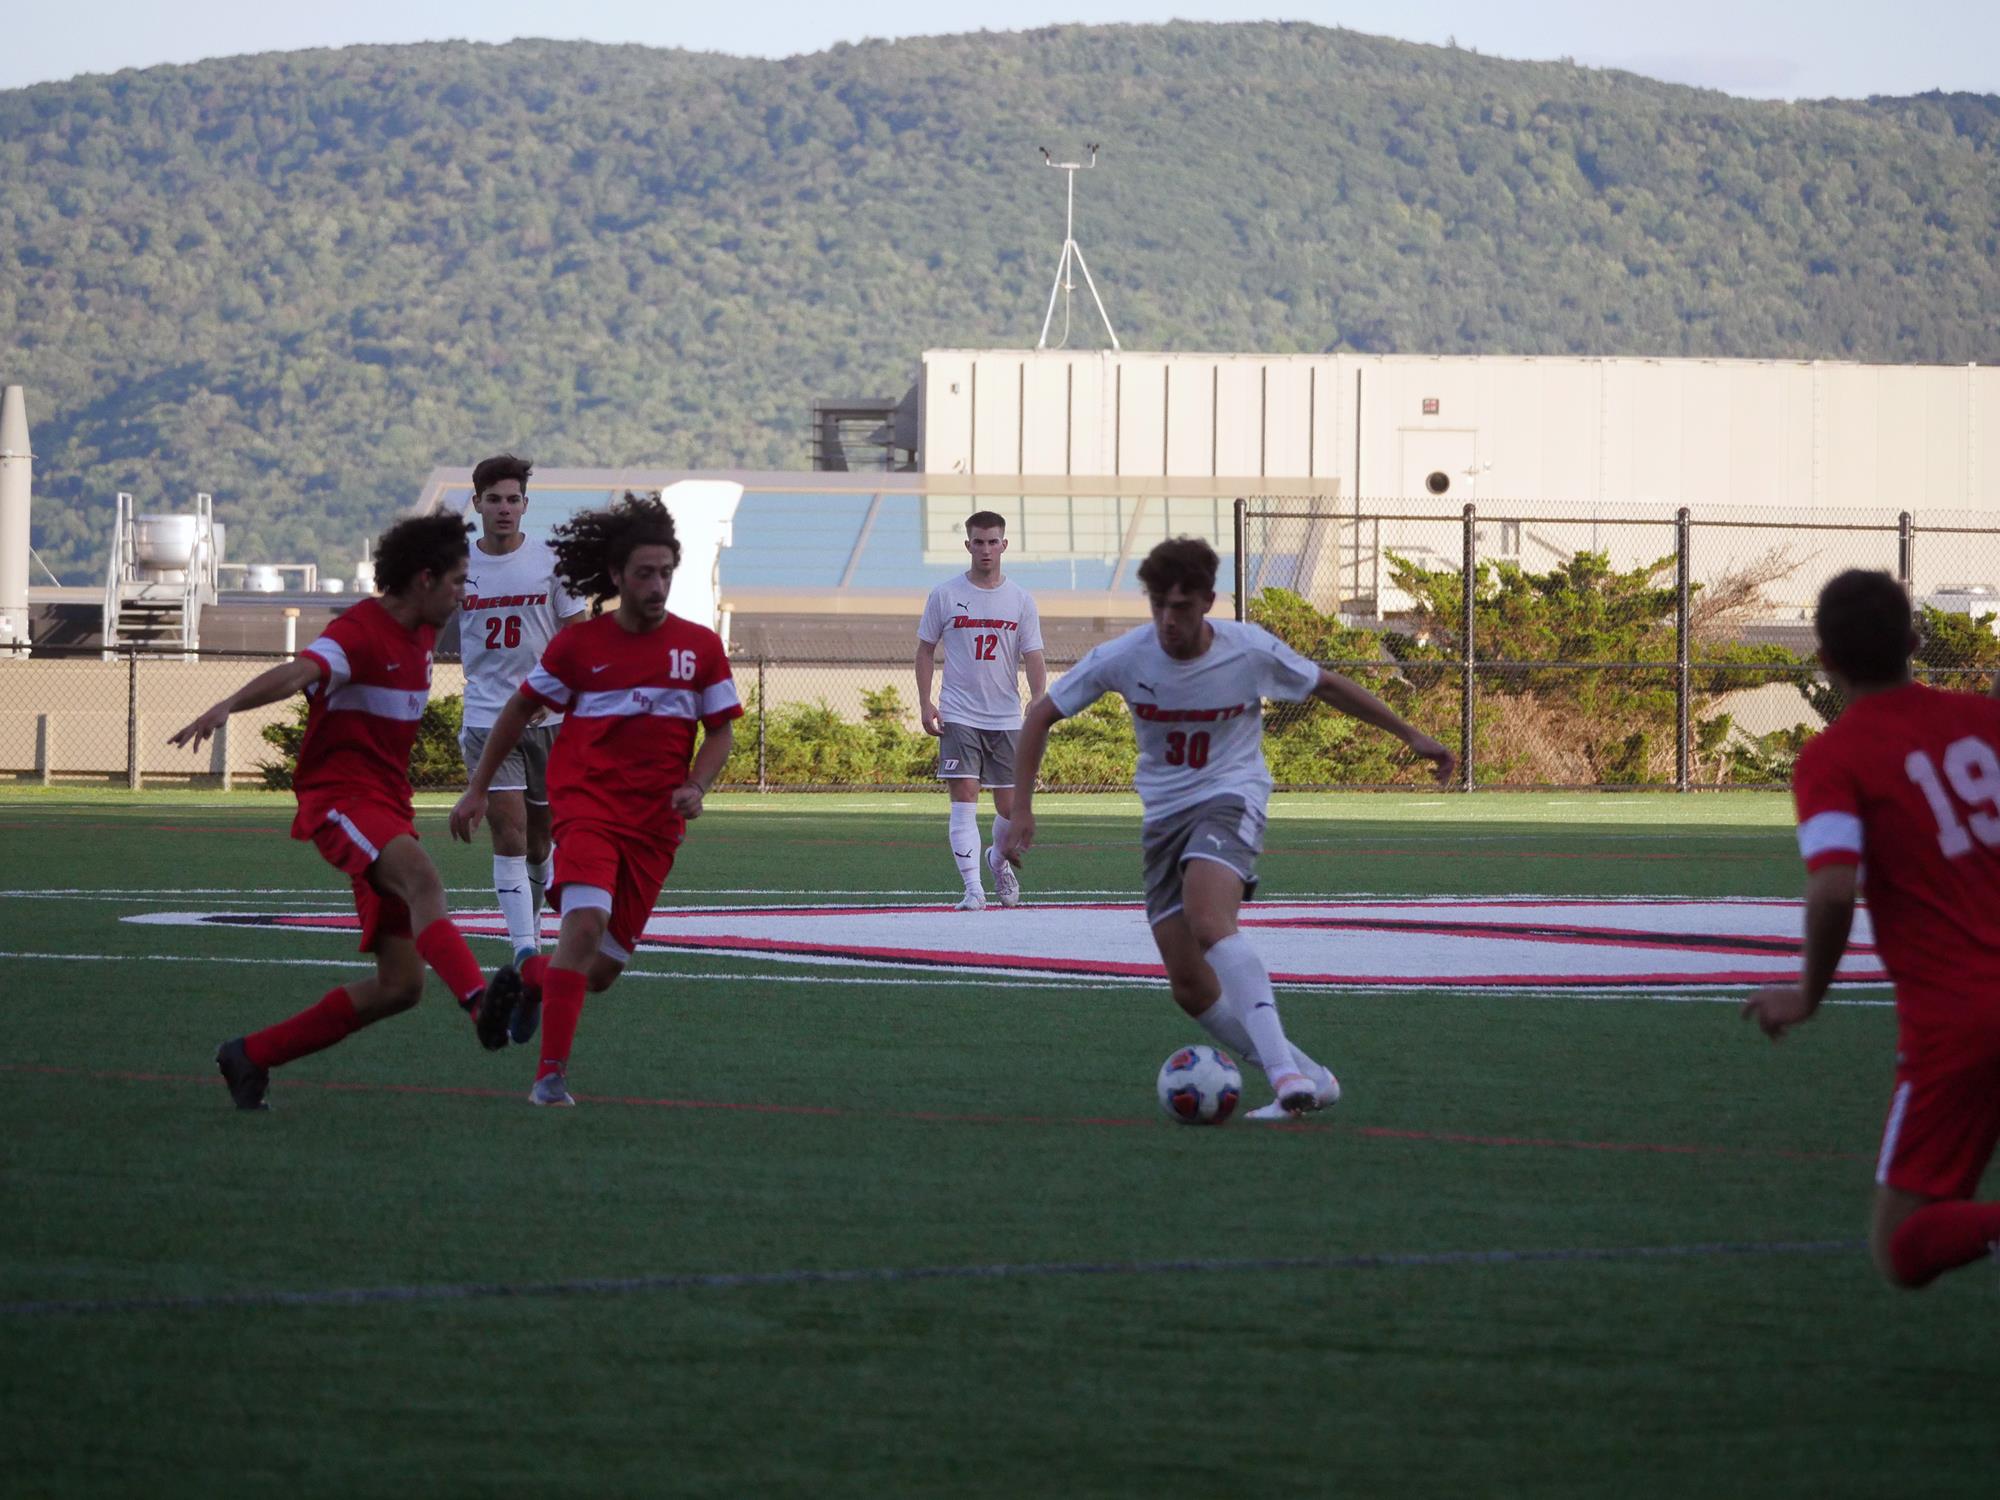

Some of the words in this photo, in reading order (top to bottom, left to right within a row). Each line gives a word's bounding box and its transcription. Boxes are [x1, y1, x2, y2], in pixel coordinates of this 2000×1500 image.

[485, 615, 521, 650] 26
[974, 634, 998, 661] 12
[669, 648, 697, 681] 16
[1165, 730, 1211, 770] 30
[1904, 734, 2000, 859] 19
